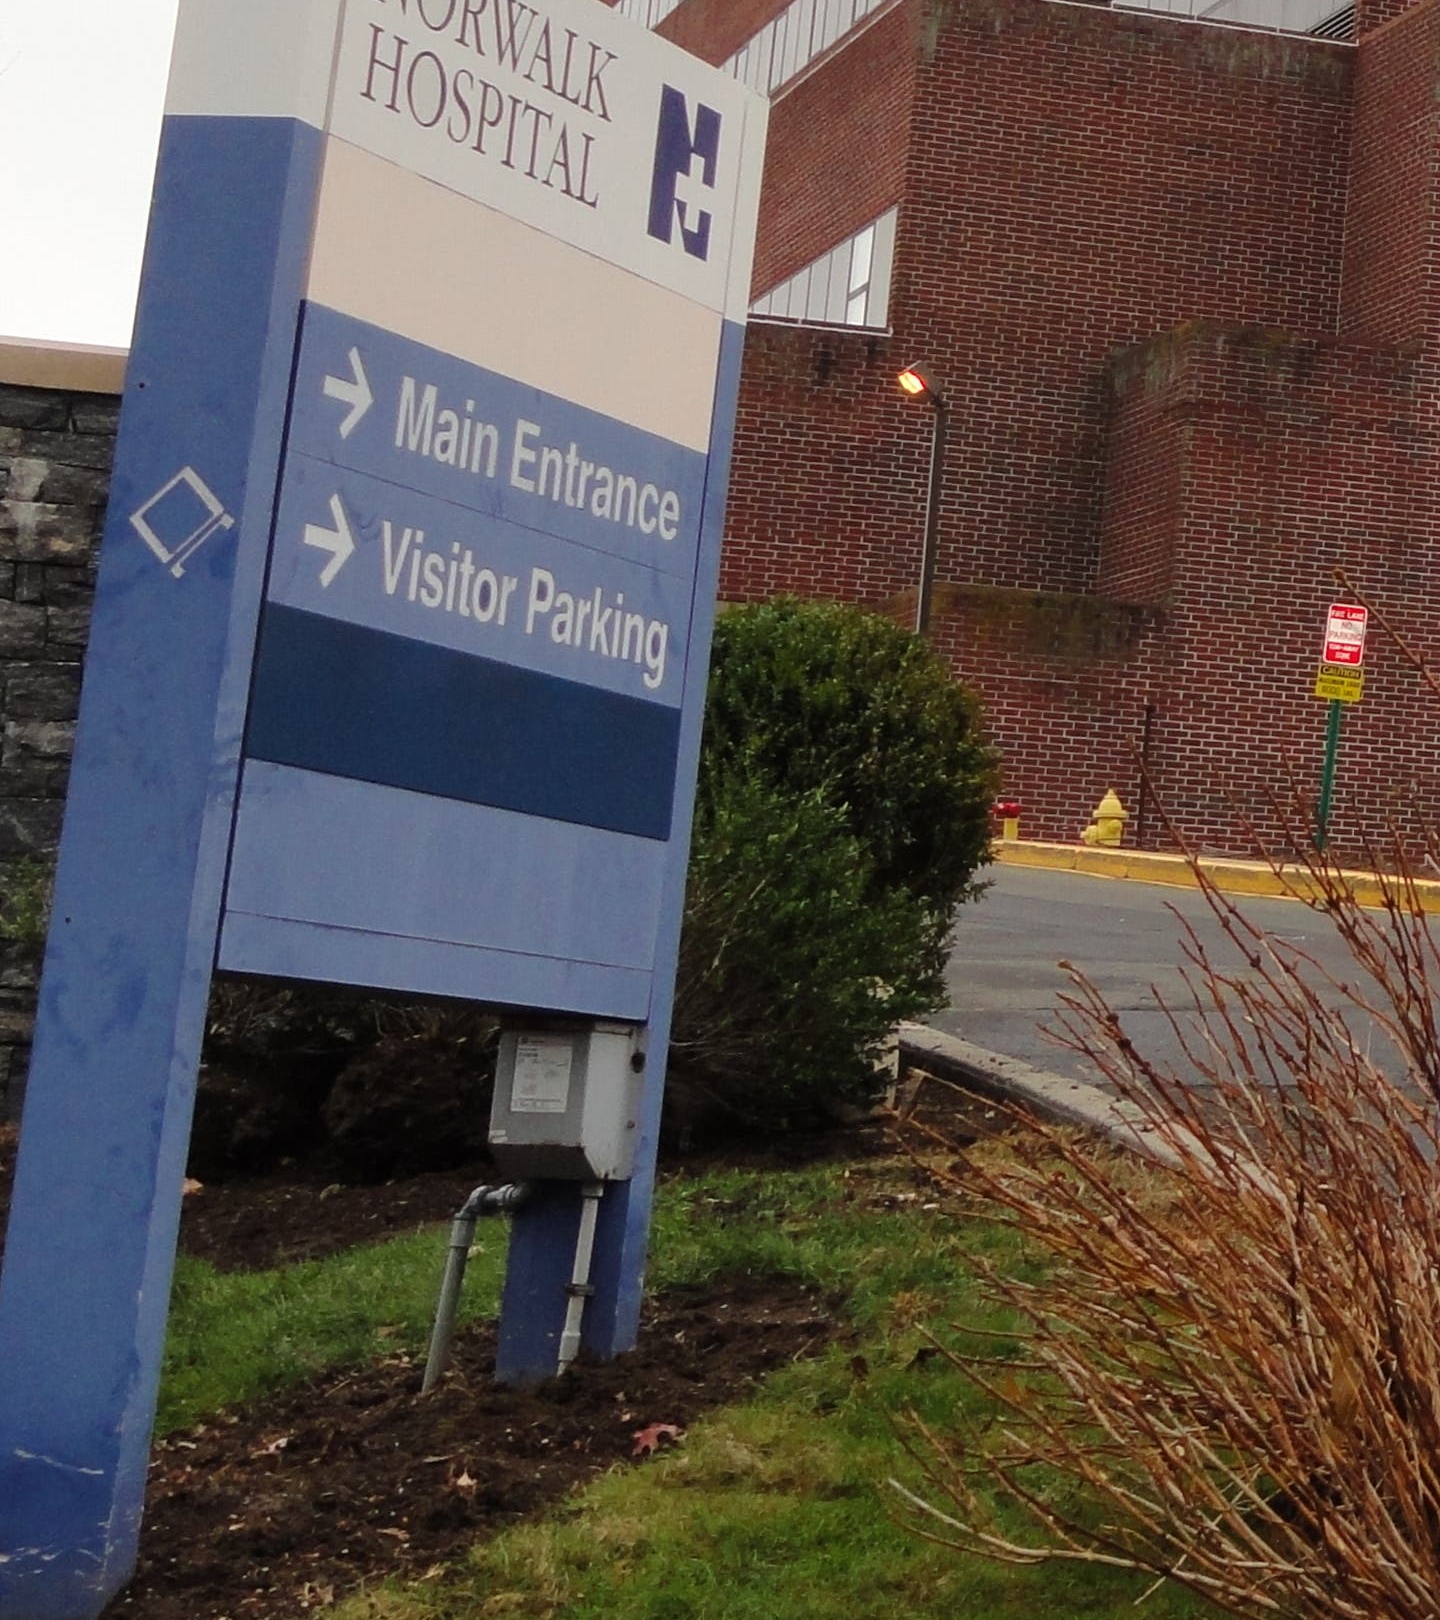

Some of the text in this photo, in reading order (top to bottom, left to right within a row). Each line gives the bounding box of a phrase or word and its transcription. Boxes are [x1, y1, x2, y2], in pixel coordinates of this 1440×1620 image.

[360, 23, 600, 208] HOSPITAL
[394, 376, 680, 540] Main Entrance
[382, 520, 669, 689] Visitor Parking
[1331, 609, 1364, 620] FIRE LANE
[1341, 622, 1353, 630] NO
[1329, 631, 1362, 641] PARKING
[1322, 666, 1360, 678] CAUTION
